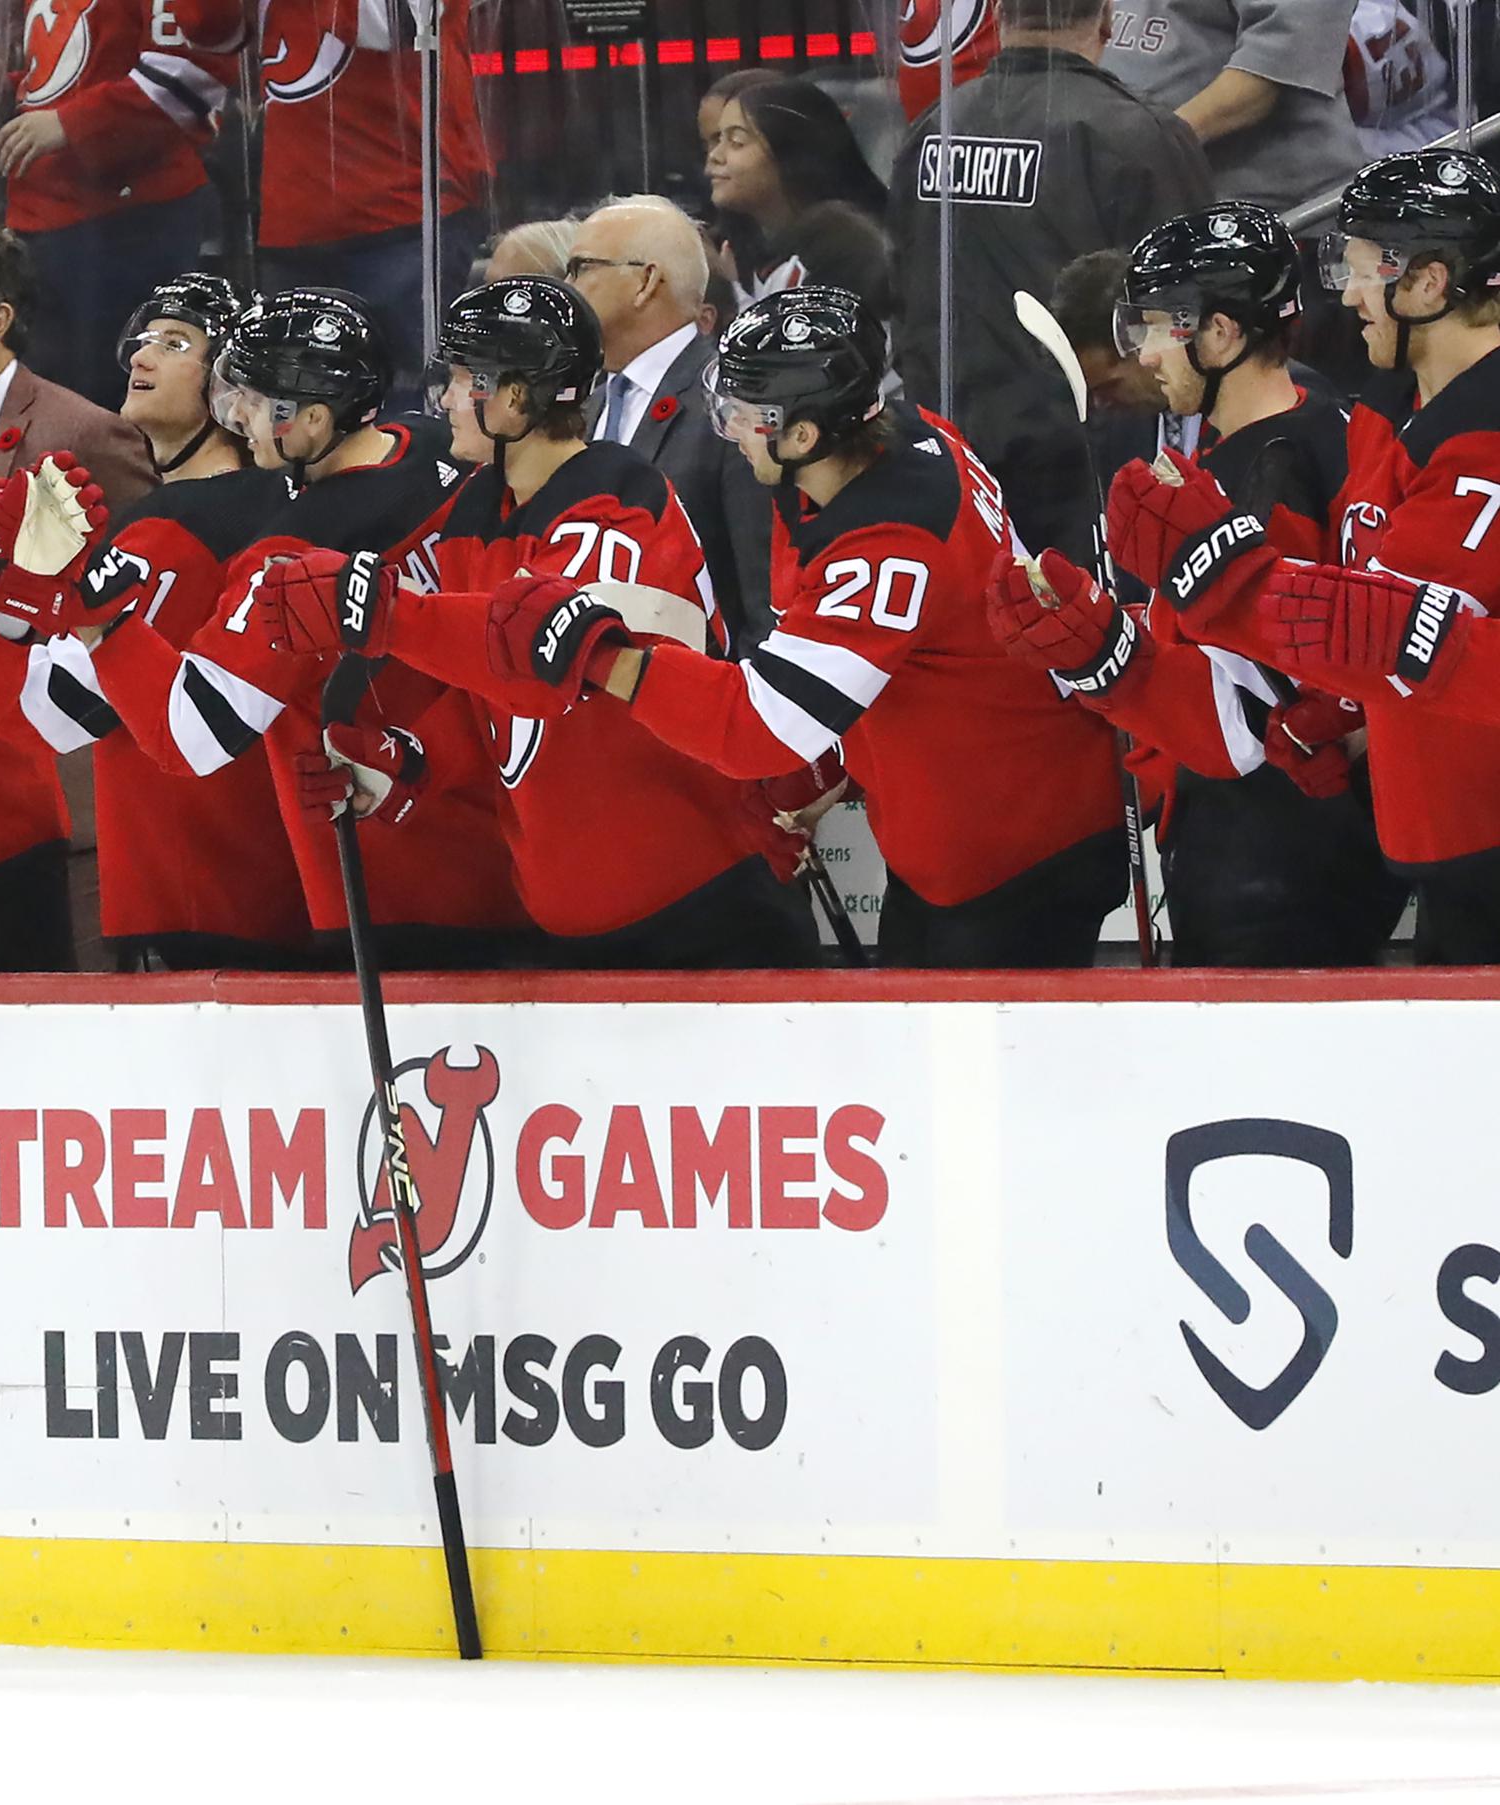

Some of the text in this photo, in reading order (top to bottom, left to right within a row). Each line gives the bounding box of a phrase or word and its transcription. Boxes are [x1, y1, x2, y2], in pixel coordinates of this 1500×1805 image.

[342, 550, 379, 633] UER
[550, 521, 642, 585] 70
[816, 556, 929, 633] 20
[516, 1104, 890, 1232] GAMES
[43, 1330, 788, 1450] LIVE ON MSG GO
